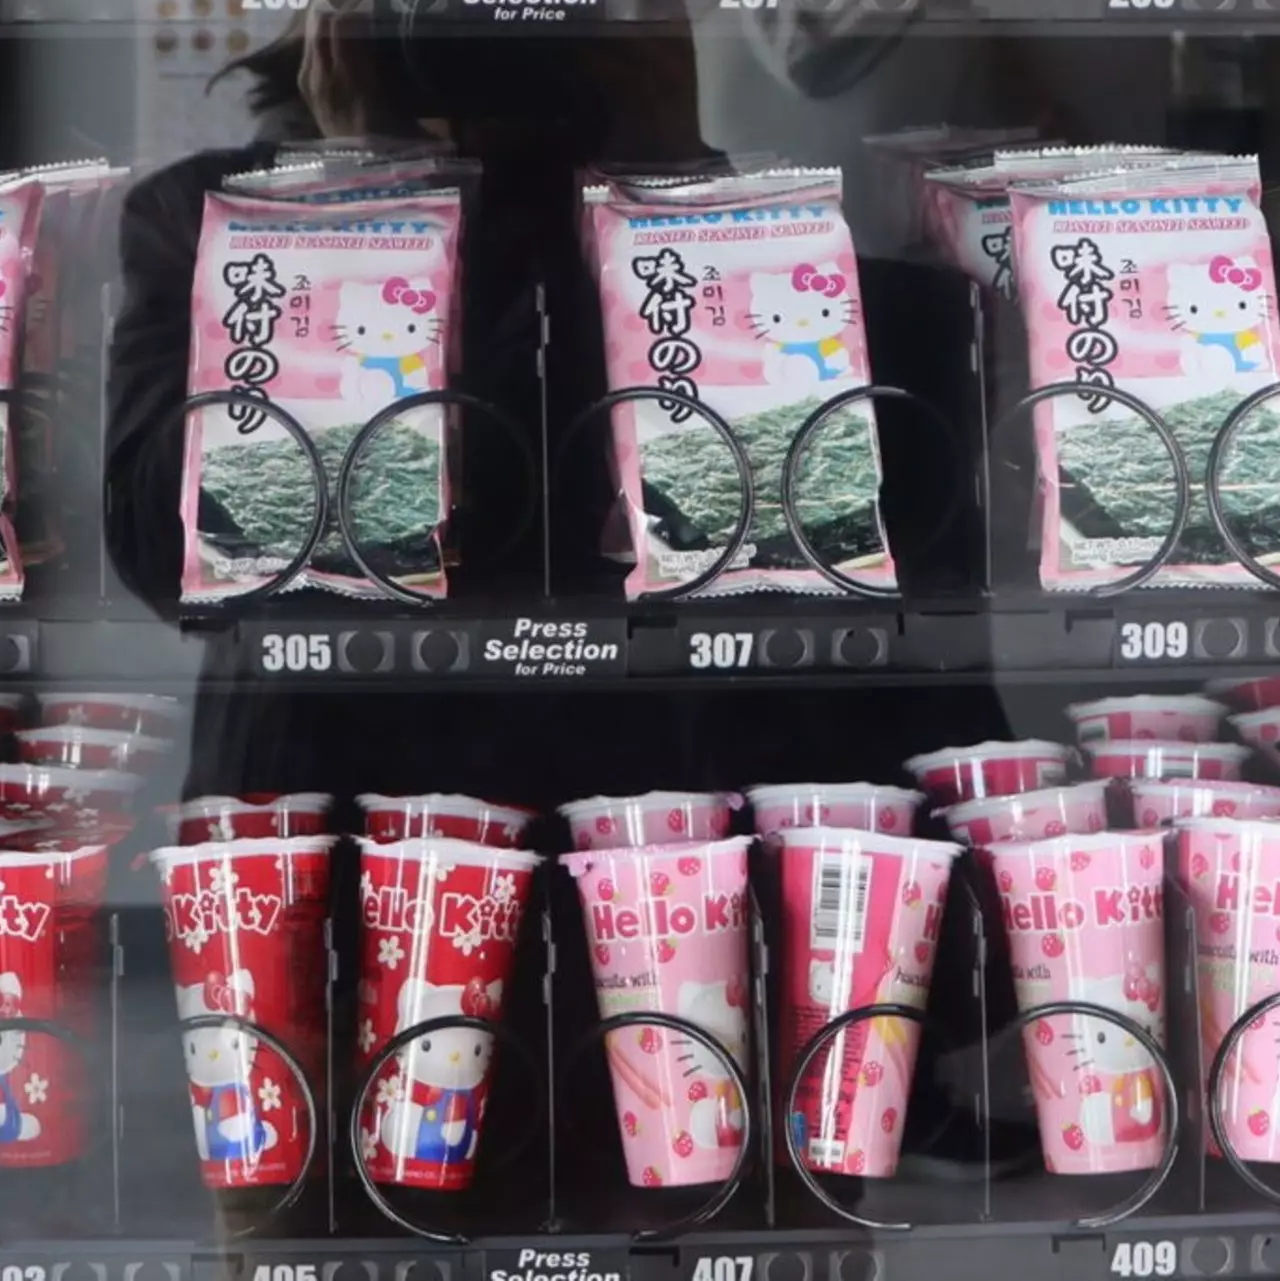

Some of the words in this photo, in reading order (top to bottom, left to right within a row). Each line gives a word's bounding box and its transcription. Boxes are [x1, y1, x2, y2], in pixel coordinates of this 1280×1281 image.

[493, 4, 519, 21] for
[521, 5, 566, 21] Price
[1048, 198, 1141, 216] HELLO
[1148, 196, 1243, 214] KITTY
[513, 618, 588, 638] Press
[1120, 622, 1188, 658] 309
[261, 634, 331, 671] 305
[483, 636, 618, 661] Selection
[690, 632, 753, 668] 307
[514, 660, 541, 676] for
[543, 661, 587, 676] Price
[171, 887, 282, 936] Kitty
[362, 885, 435, 932] ello
[591, 897, 696, 941] Hello
[1248, 948, 1280, 966] with
[1025, 963, 1052, 980] with
[517, 1248, 592, 1269] Press
[691, 1255, 754, 1281] 407
[1110, 1241, 1178, 1277] 409
